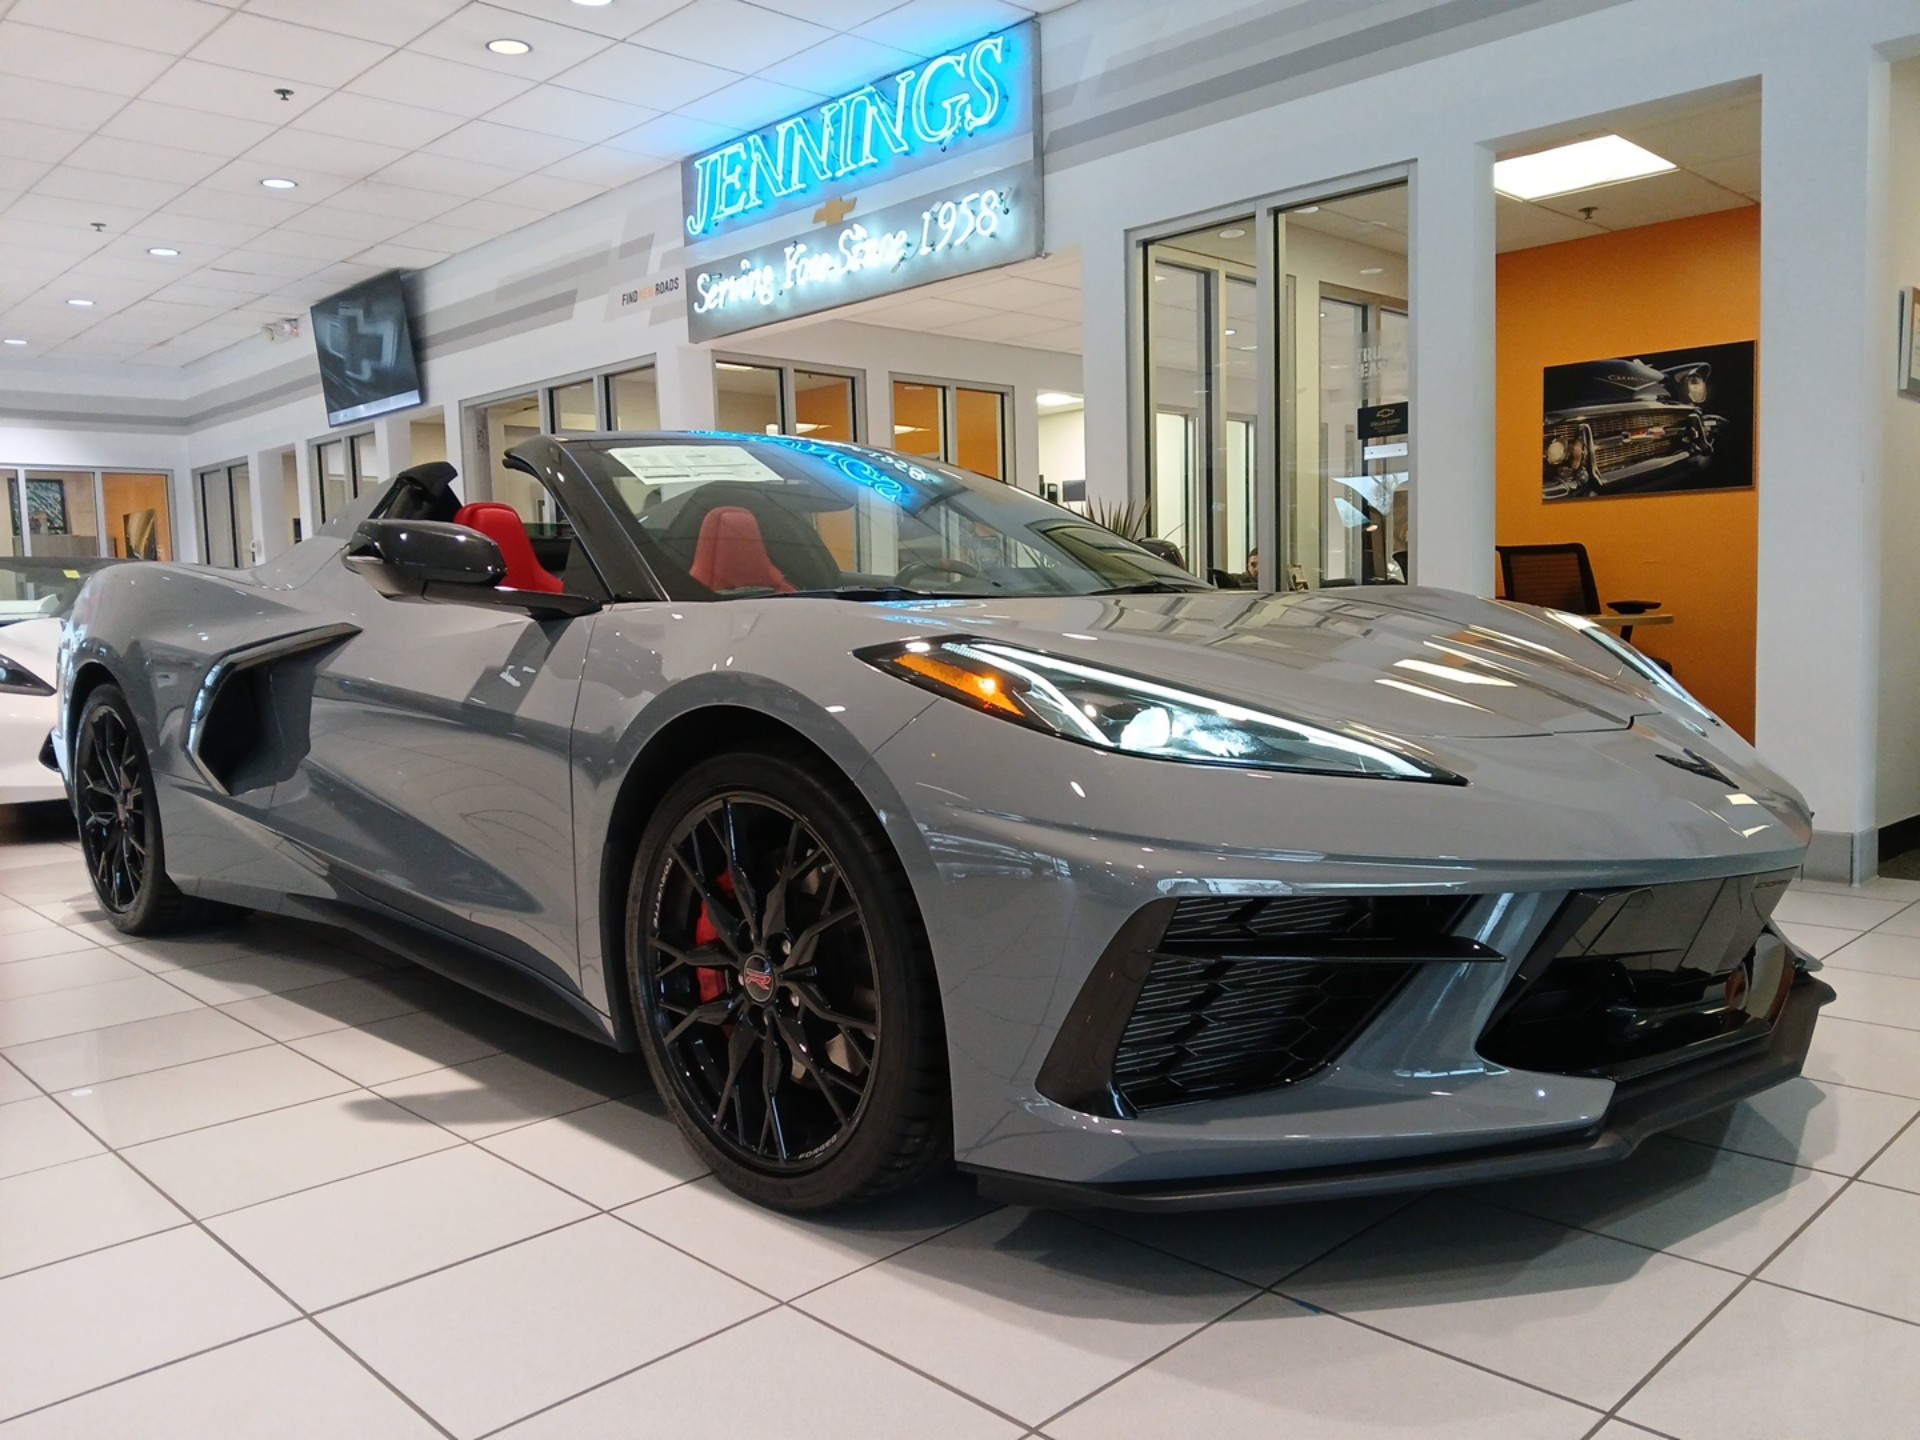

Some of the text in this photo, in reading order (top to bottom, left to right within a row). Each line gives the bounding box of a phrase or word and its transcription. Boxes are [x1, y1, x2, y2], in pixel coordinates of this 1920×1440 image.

[686, 36, 1004, 236] JENNINGS
[693, 259, 775, 314] Serving
[920, 189, 999, 256] 1958
[622, 290, 638, 306] FIND
[655, 276, 680, 296] ROADS
[798, 1134, 838, 1160] FORGED
